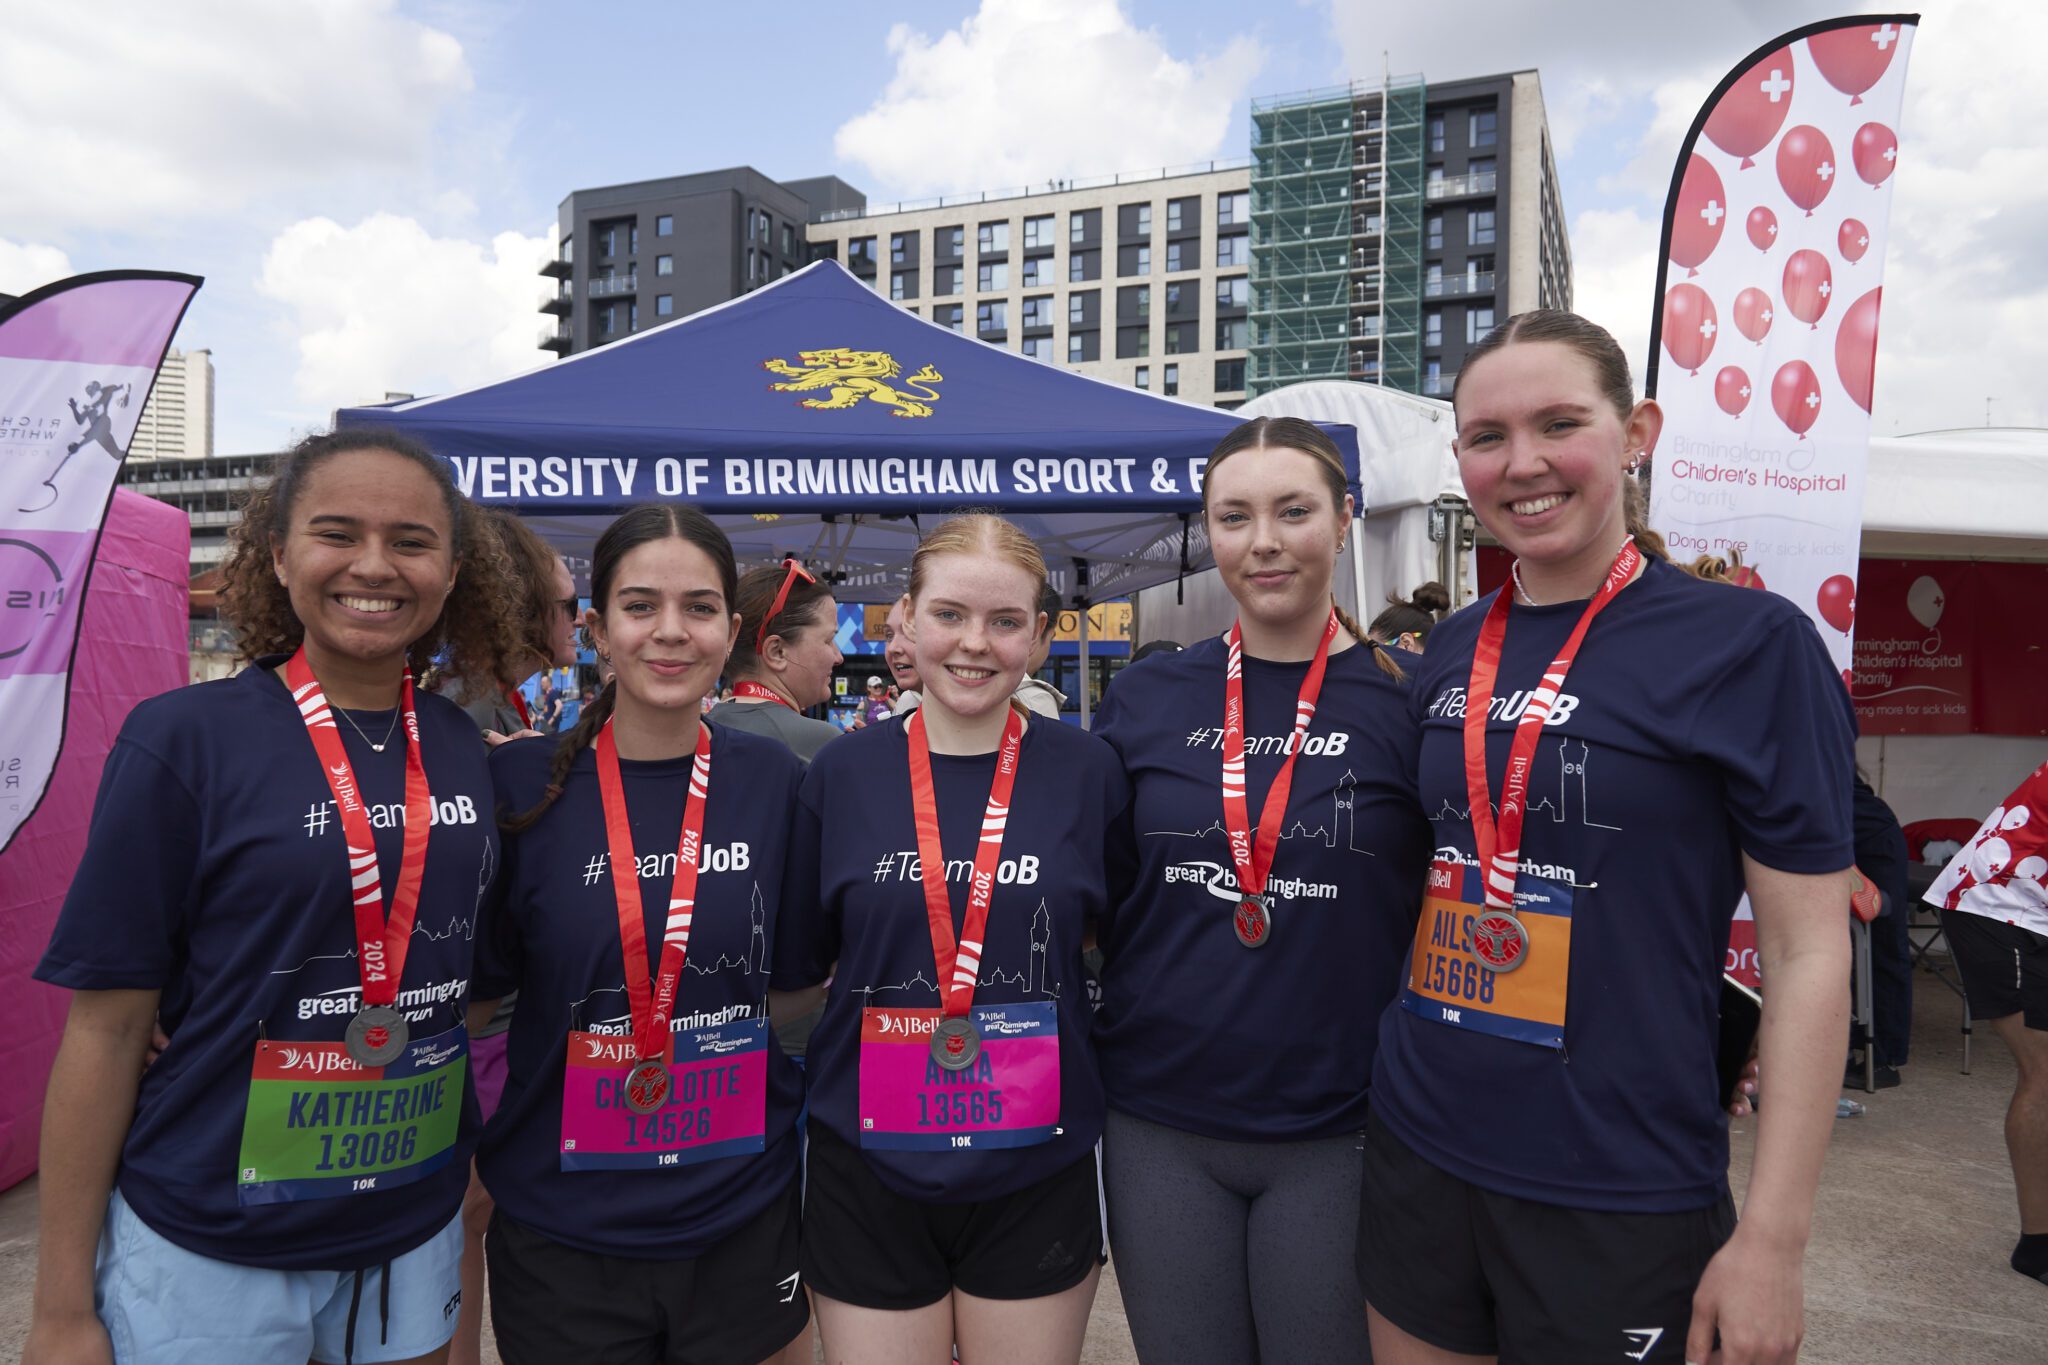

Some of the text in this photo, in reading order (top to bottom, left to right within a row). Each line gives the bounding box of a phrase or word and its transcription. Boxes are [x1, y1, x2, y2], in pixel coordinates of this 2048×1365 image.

[450, 456, 639, 498] VERSITY
[655, 458, 709, 496] OF
[725, 457, 1000, 495] BIRMINGHAM
[1013, 457, 1136, 493] SPORT
[1150, 457, 1179, 493] &
[1672, 459, 1846, 496] Children's Hospital
[1670, 483, 1738, 510] Charity
[1855, 638, 1920, 654] rmingham
[1908, 654, 1963, 670] Hospital
[1855, 703, 1967, 717] oing more for sick kids
[333, 774, 360, 813] AJBell
[1508, 757, 1528, 802] AJBell
[680, 829, 699, 866] 2024
[1232, 830, 1249, 866] 2024
[874, 851, 1040, 885] #TemoB
[1165, 865, 1338, 899] great bingham
[972, 870, 991, 909] 2024
[1514, 891, 1551, 903] rmingham
[1431, 910, 1473, 953] AILS
[363, 941, 387, 983] 2024
[1423, 953, 1496, 1004] 15668
[297, 993, 359, 1020] great
[659, 973, 676, 1014] AJBell
[404, 1006, 434, 1023] run
[669, 1003, 752, 1033] rmingham
[890, 1016, 940, 1037] AJBell
[1442, 1008, 1461, 1023] 10K
[601, 1042, 637, 1063] AJB
[287, 1074, 447, 1129] KATHERINE
[595, 1063, 741, 1109] CHLOTTE
[917, 1089, 1003, 1126] 13565
[624, 1106, 711, 1146] 14526
[951, 1136, 972, 1147] 10K
[315, 1125, 418, 1172] 13086
[657, 1153, 679, 1165] 10K
[352, 1177, 377, 1191] 10K
